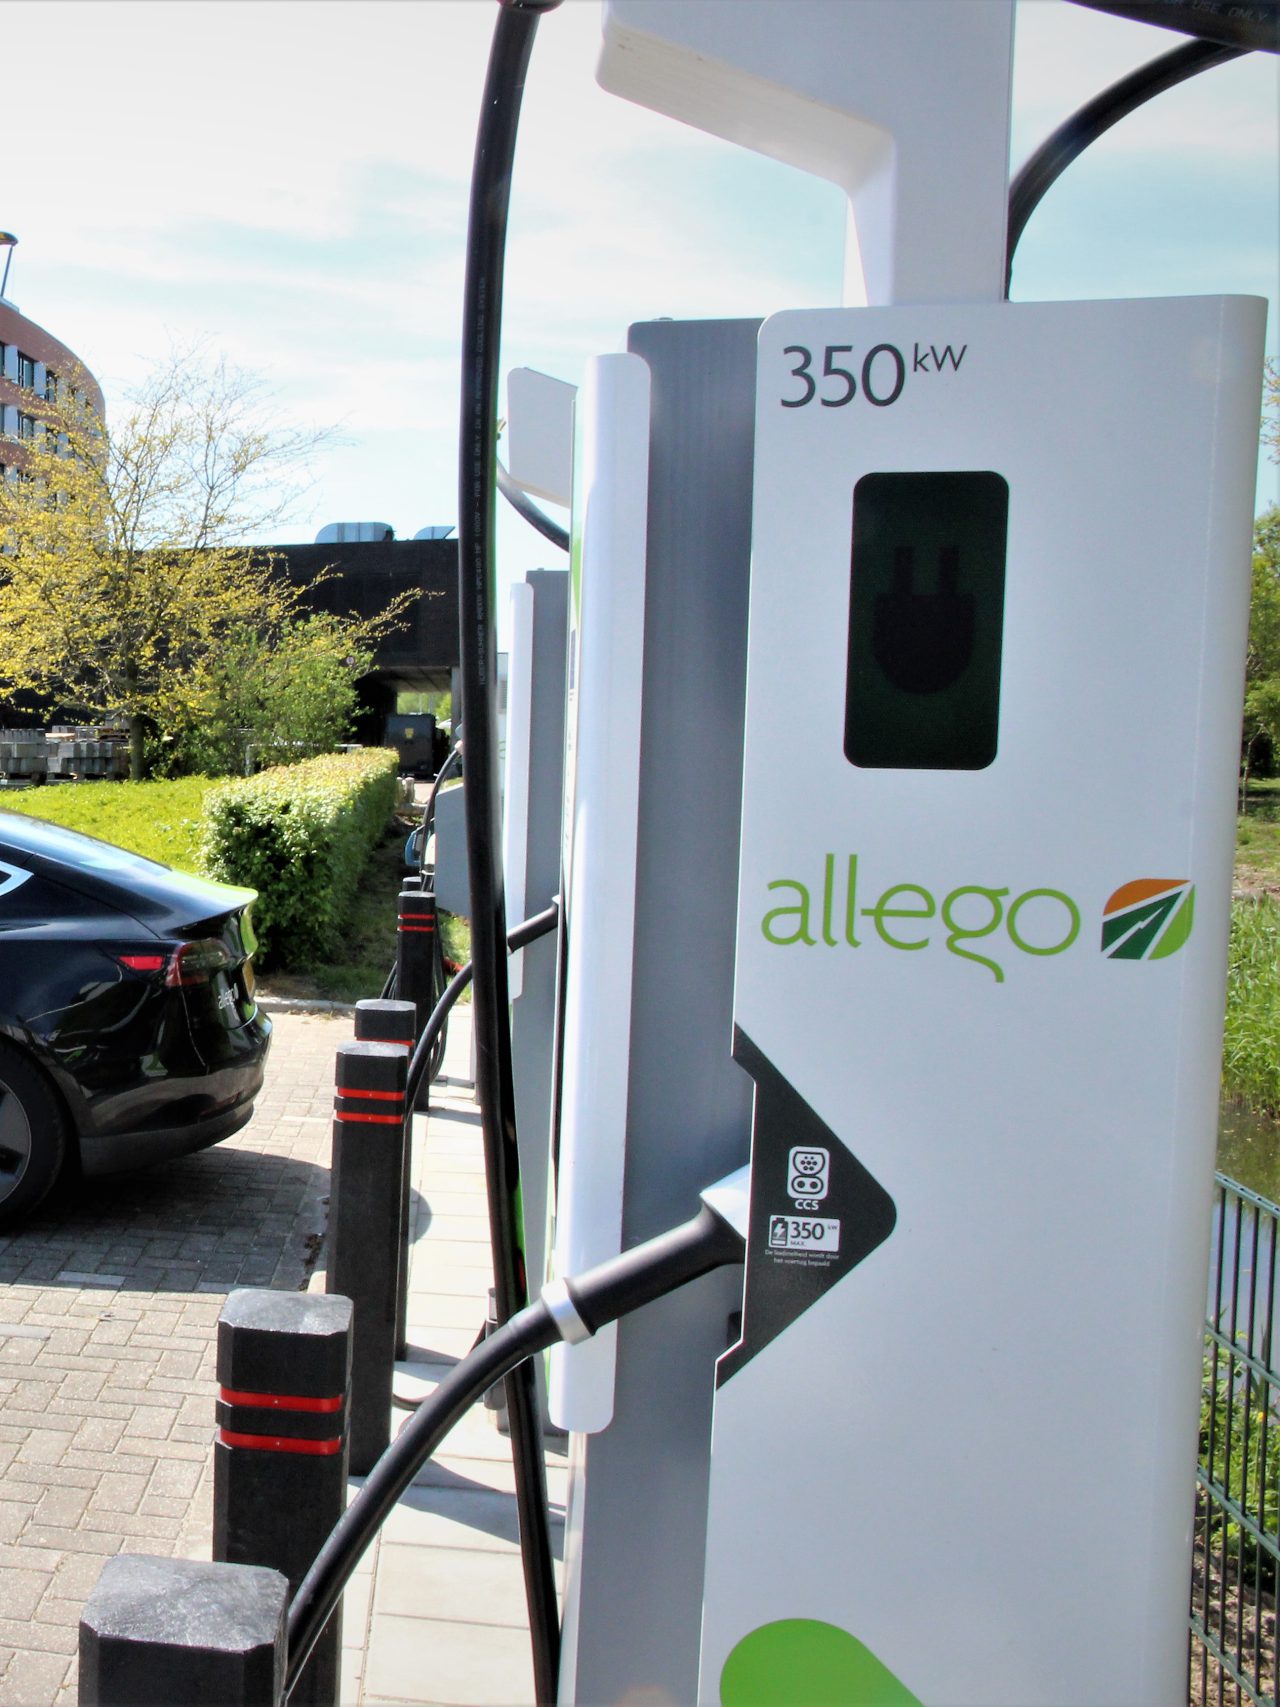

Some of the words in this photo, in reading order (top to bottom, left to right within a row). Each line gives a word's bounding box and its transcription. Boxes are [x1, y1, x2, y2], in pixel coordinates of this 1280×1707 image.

[780, 343, 906, 408] 350
[913, 342, 968, 372] kW
[473, 434, 481, 456] ONLY
[473, 462, 481, 477] USE
[473, 481, 481, 497] FOR
[473, 511, 481, 537] 1000V
[761, 853, 1081, 983] allego
[795, 1199, 819, 1210] CCS
[790, 1221, 825, 1240] 350
